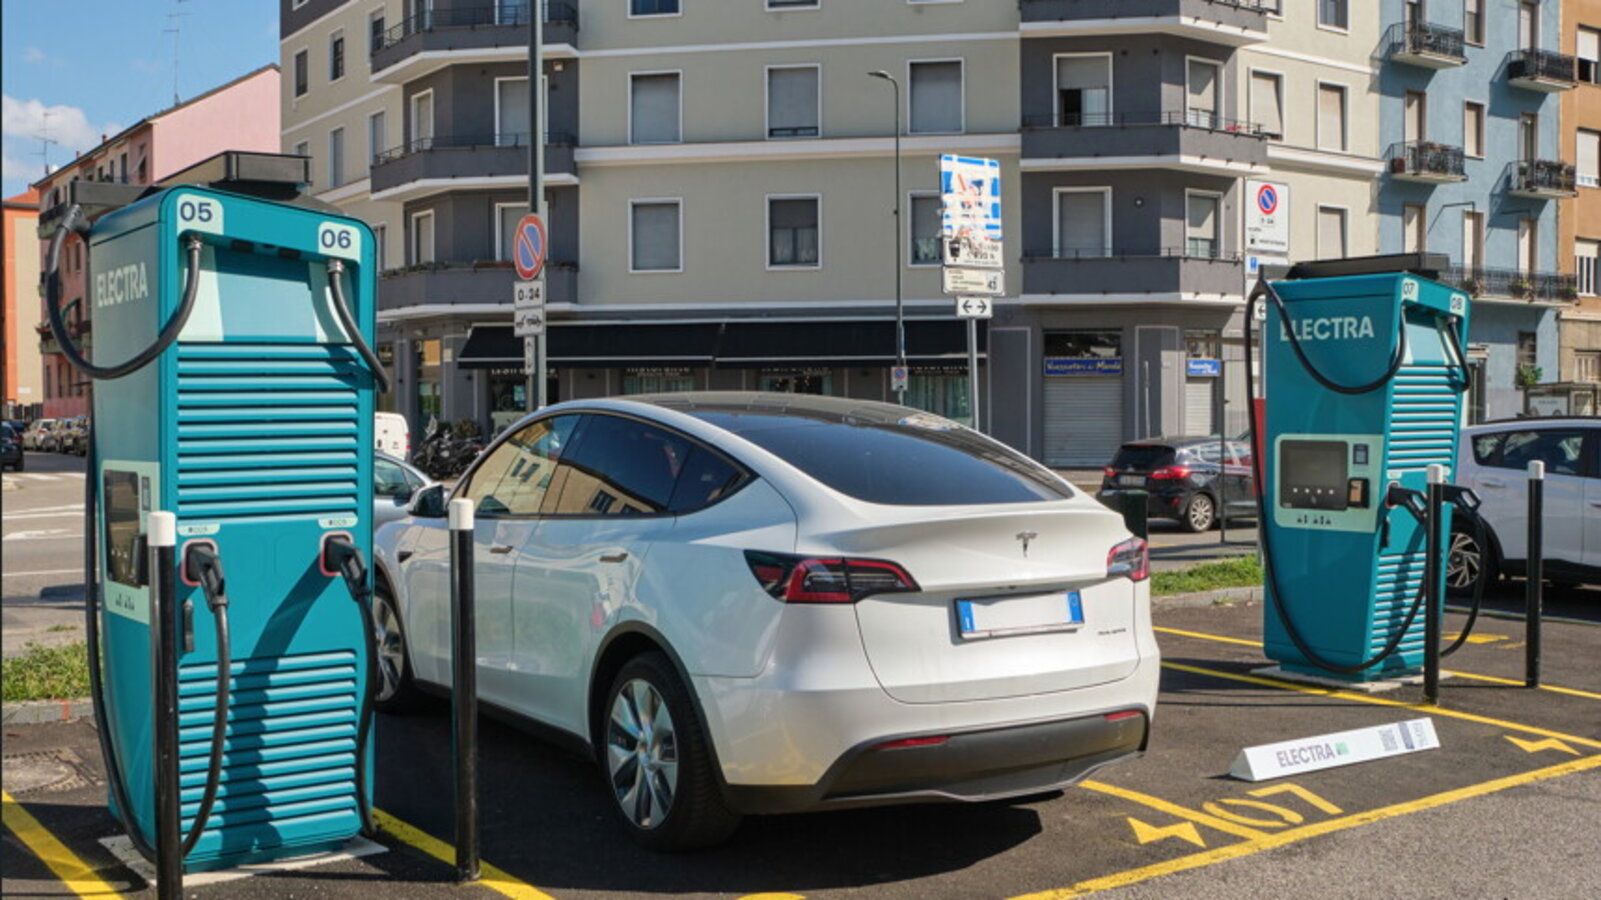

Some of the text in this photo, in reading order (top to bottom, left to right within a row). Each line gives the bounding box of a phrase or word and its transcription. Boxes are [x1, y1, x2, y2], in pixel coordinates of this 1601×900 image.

[180, 202, 212, 223] 05
[321, 229, 351, 249] 06
[97, 262, 148, 307] ELECTRA
[1403, 282, 1414, 294] 07
[1451, 297, 1462, 310] 08
[1276, 743, 1336, 768] ELECTRA
[1202, 782, 1345, 827] 07
